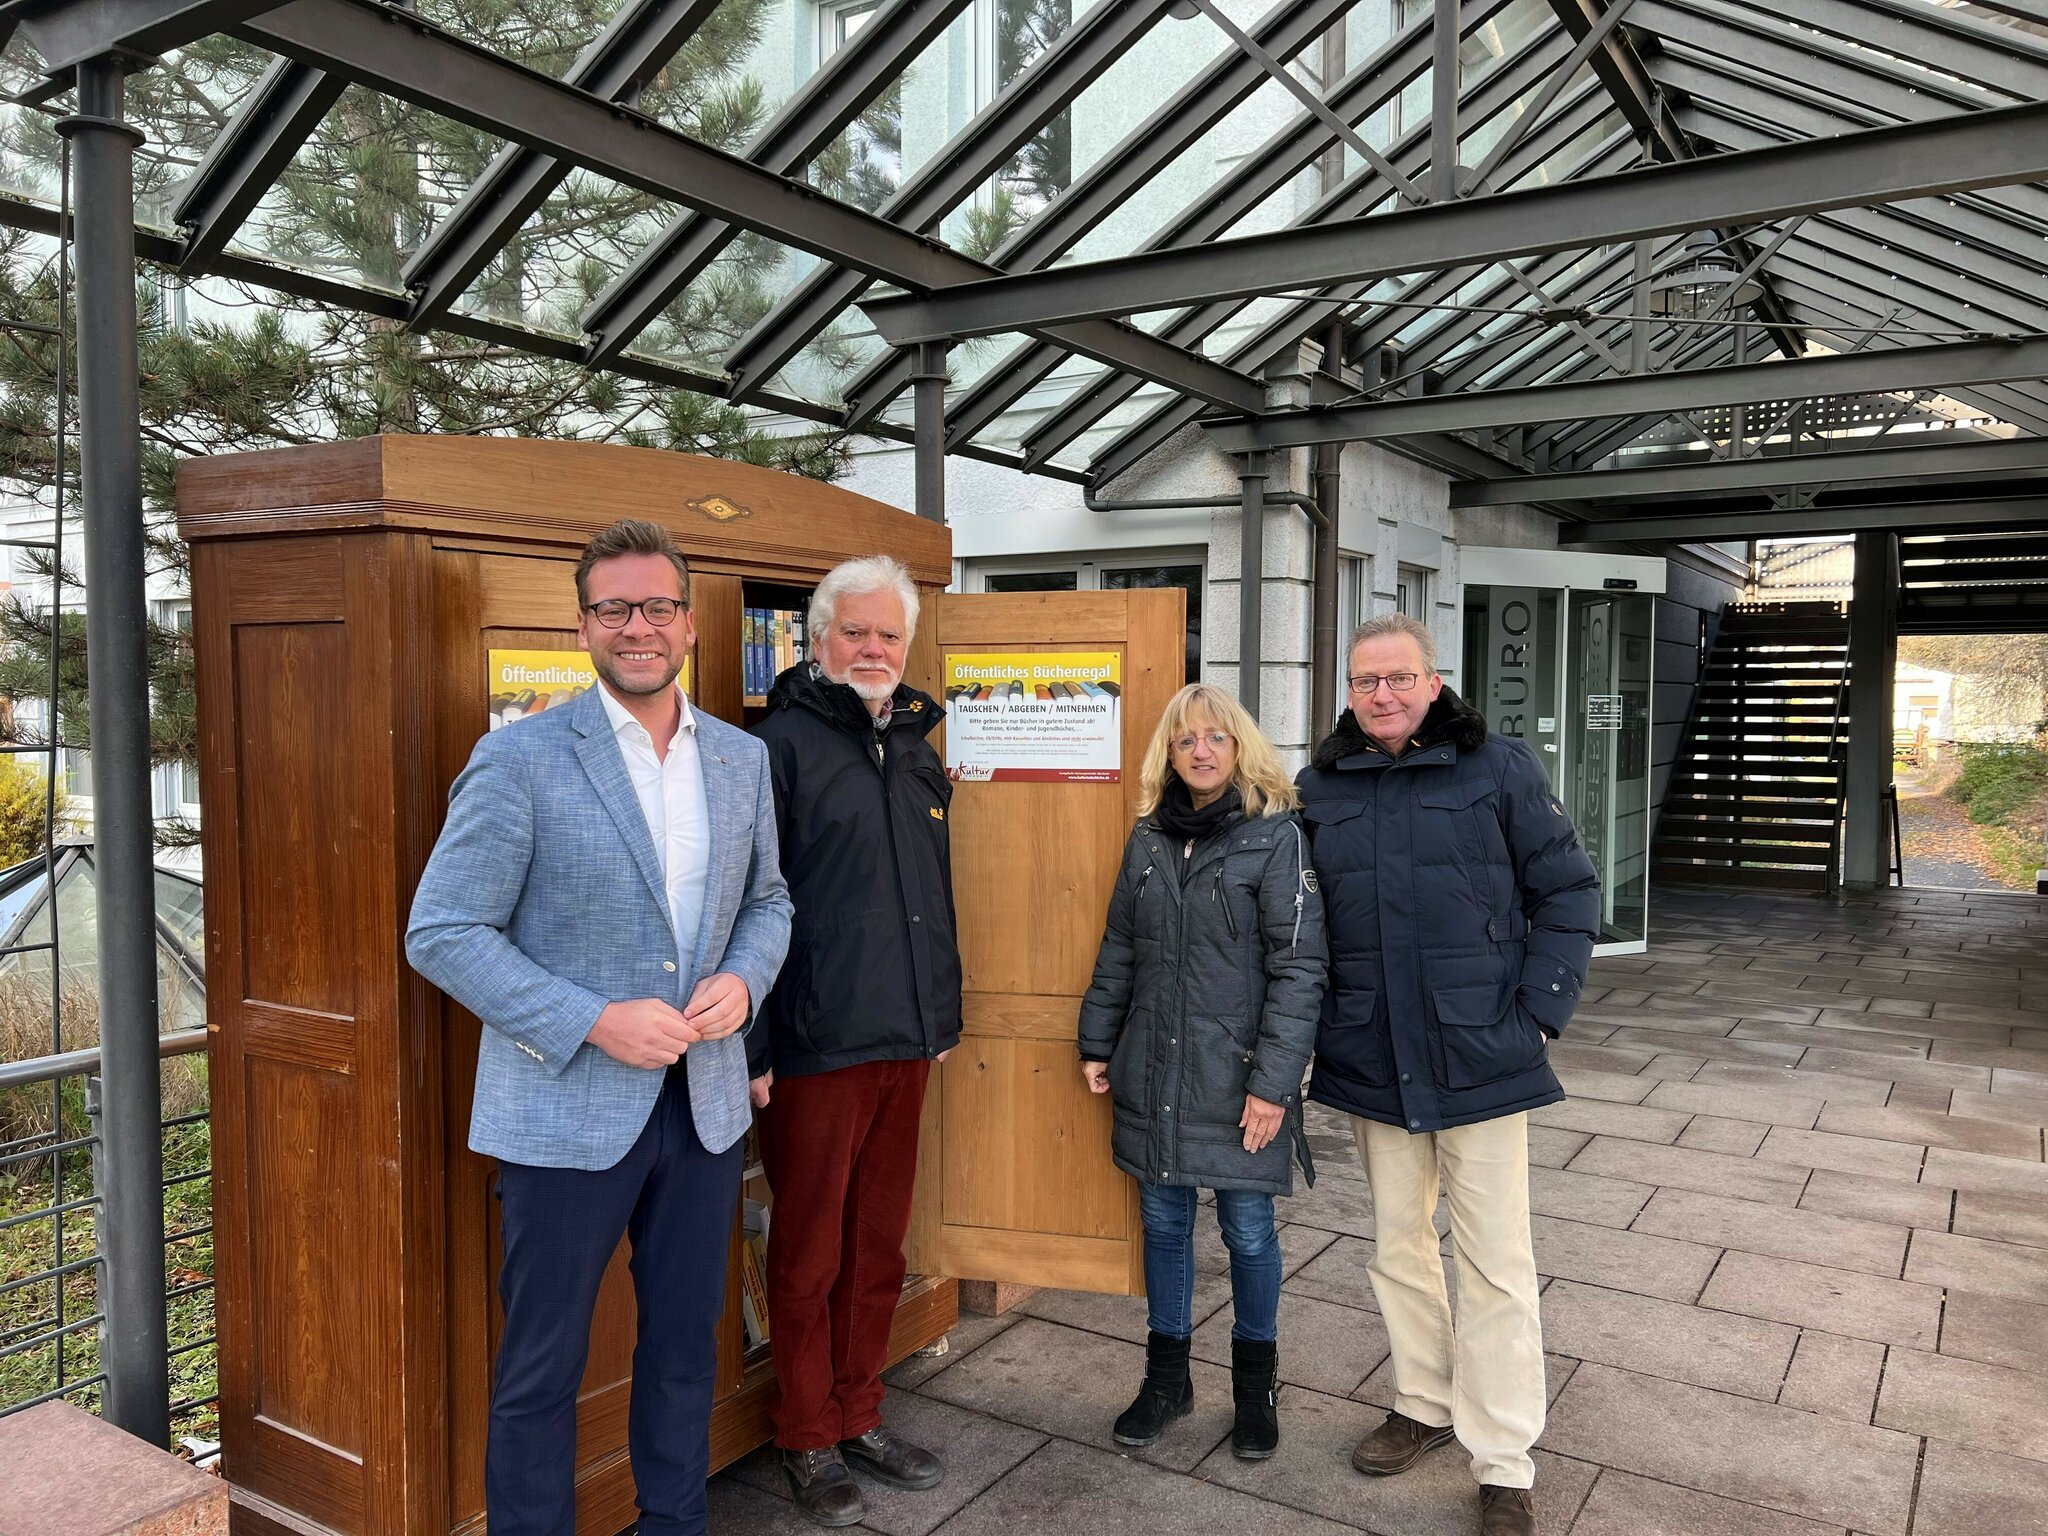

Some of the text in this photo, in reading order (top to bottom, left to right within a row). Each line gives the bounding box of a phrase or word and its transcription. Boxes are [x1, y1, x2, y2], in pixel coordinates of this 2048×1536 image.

[502, 664, 593, 684] Öffentliches
[954, 664, 1110, 681] Öffentliches Bücherregal
[959, 704, 999, 713] TAUSCHEN
[1008, 704, 1047, 713] ABGEBEN
[1056, 704, 1107, 713] MITNEHMEN
[959, 761, 990, 776] Kultur
